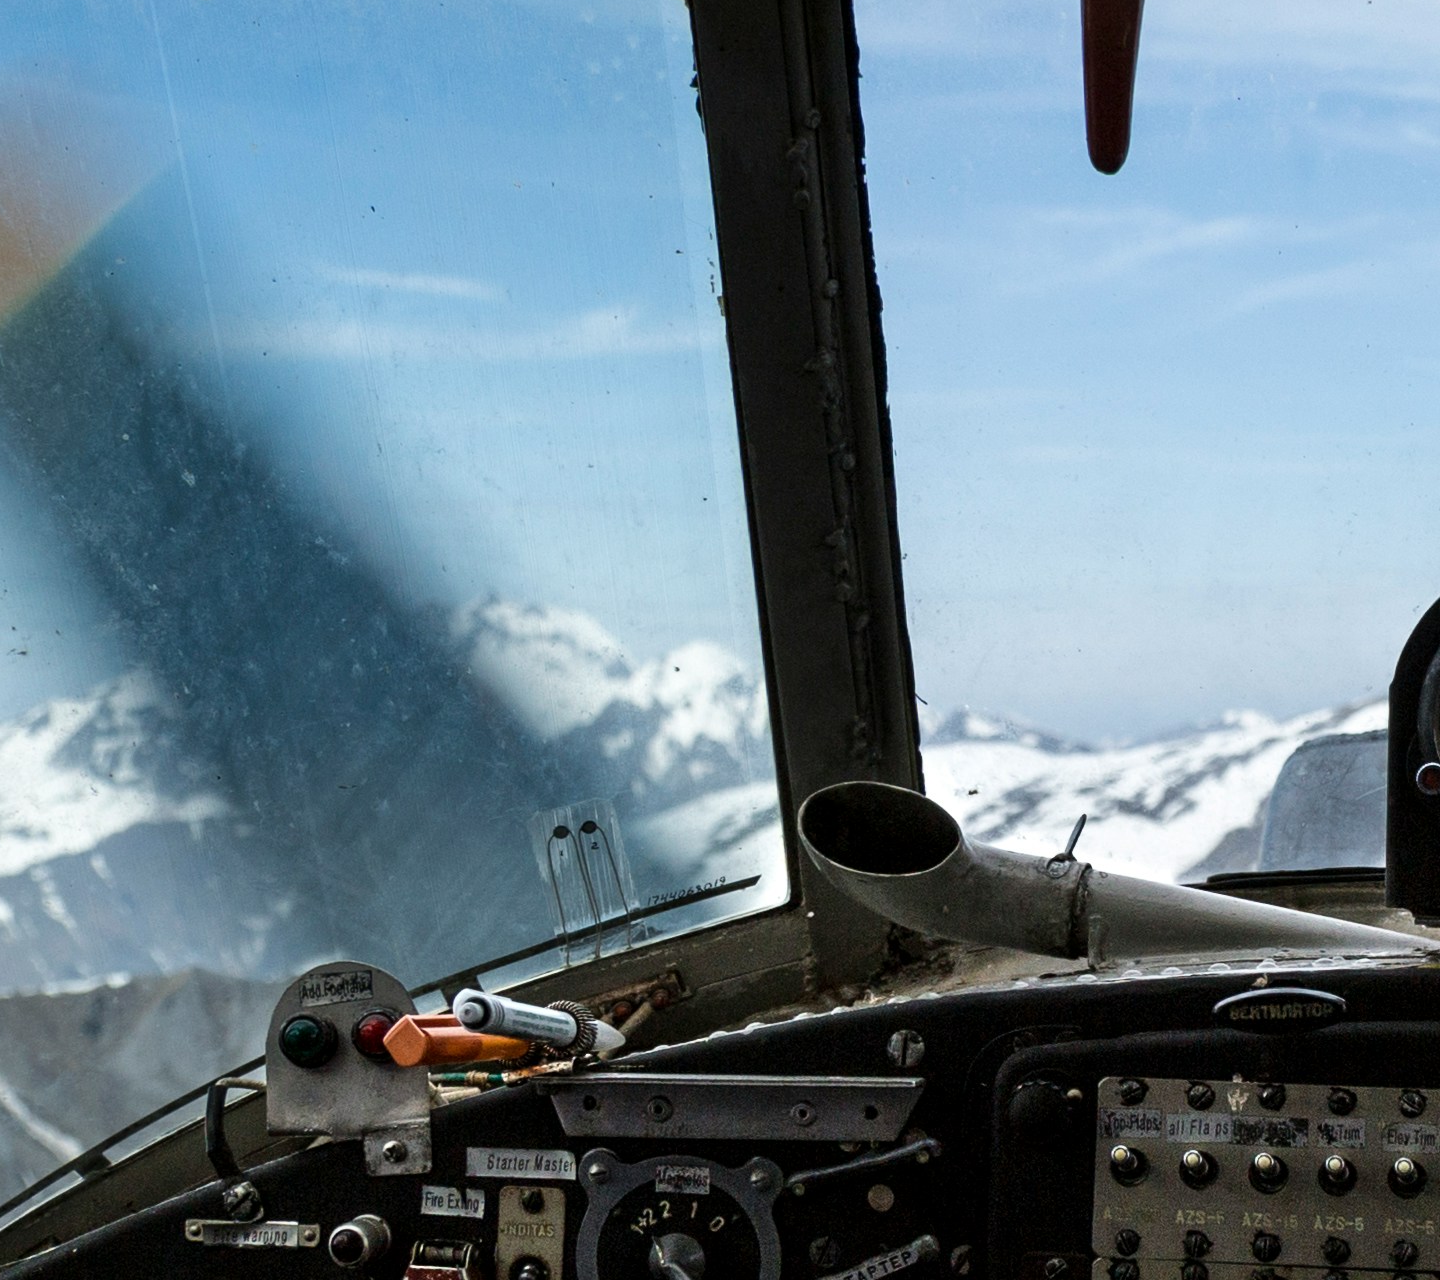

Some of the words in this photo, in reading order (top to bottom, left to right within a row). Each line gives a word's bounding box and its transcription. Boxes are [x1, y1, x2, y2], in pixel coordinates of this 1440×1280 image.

[487, 1153, 535, 1172] Starter
[539, 1155, 575, 1174] Master
[425, 1192, 444, 1208] Fire
